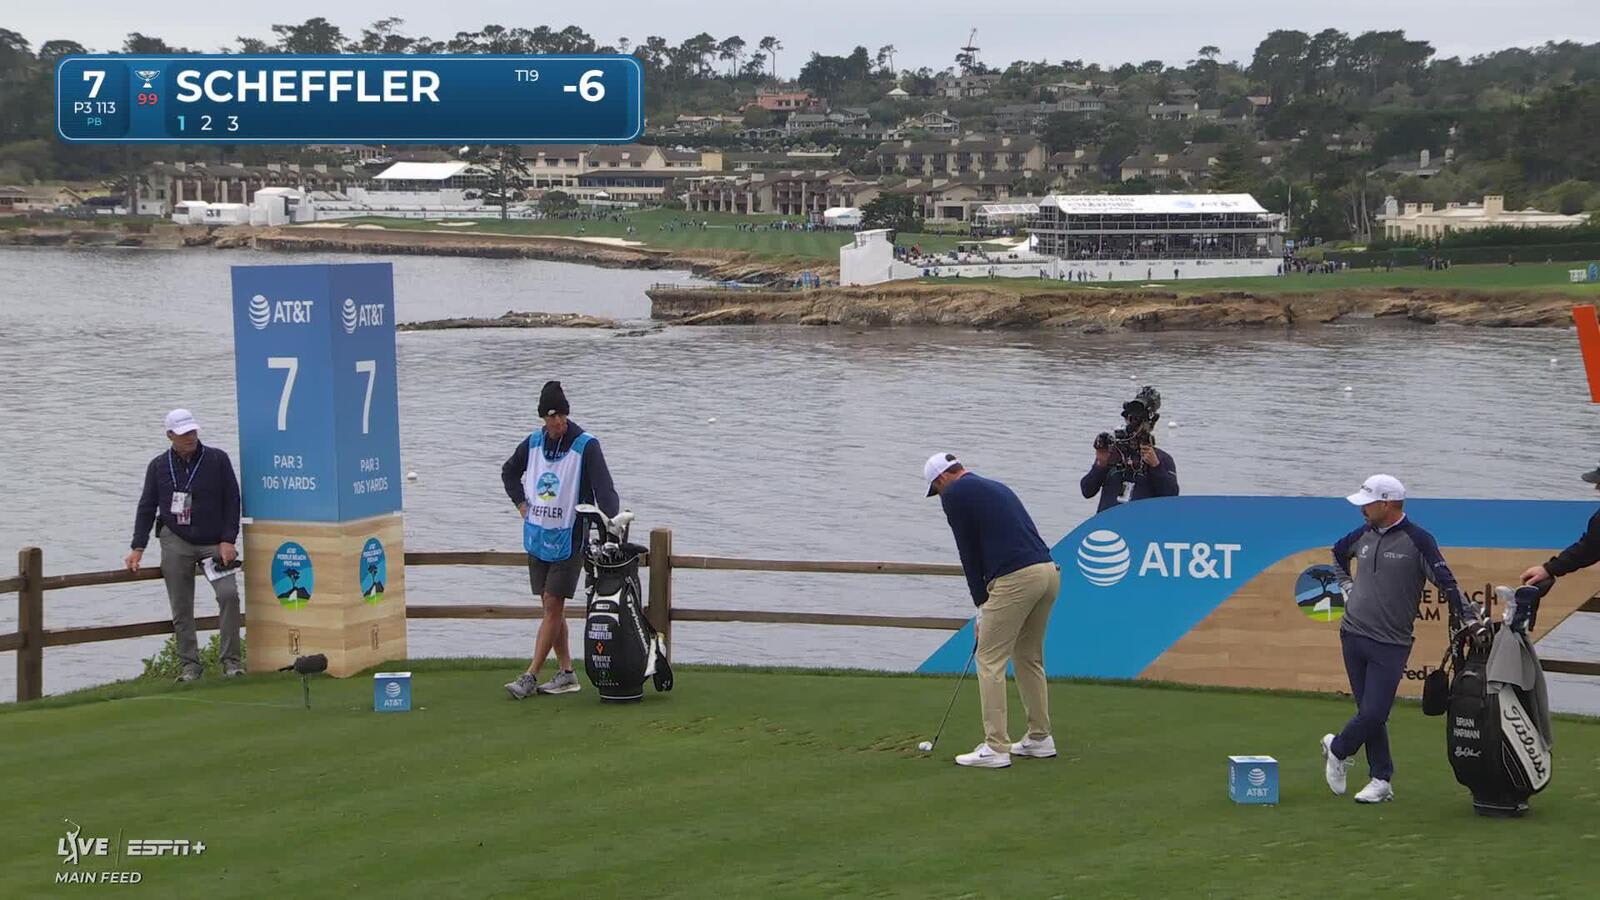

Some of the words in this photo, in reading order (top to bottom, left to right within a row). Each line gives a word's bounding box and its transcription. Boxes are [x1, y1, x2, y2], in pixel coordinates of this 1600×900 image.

[273, 300, 314, 323] AT&T
[359, 303, 385, 327] AT&T
[267, 357, 299, 431] 7
[355, 360, 376, 434] 7
[274, 455, 296, 469] PAR
[296, 455, 303, 469] 3
[360, 458, 374, 473] PAR
[374, 457, 380, 471] 3
[262, 475, 279, 489] 106
[281, 476, 316, 491] YARDS
[366, 477, 388, 493] YARDS
[1138, 541, 1242, 579] AT&T
[1456, 717, 1475, 728] BRIAN
[1453, 728, 1480, 740] HARMAN
[1504, 705, 1546, 780] Titleist
[1247, 788, 1269, 797] AT&T
